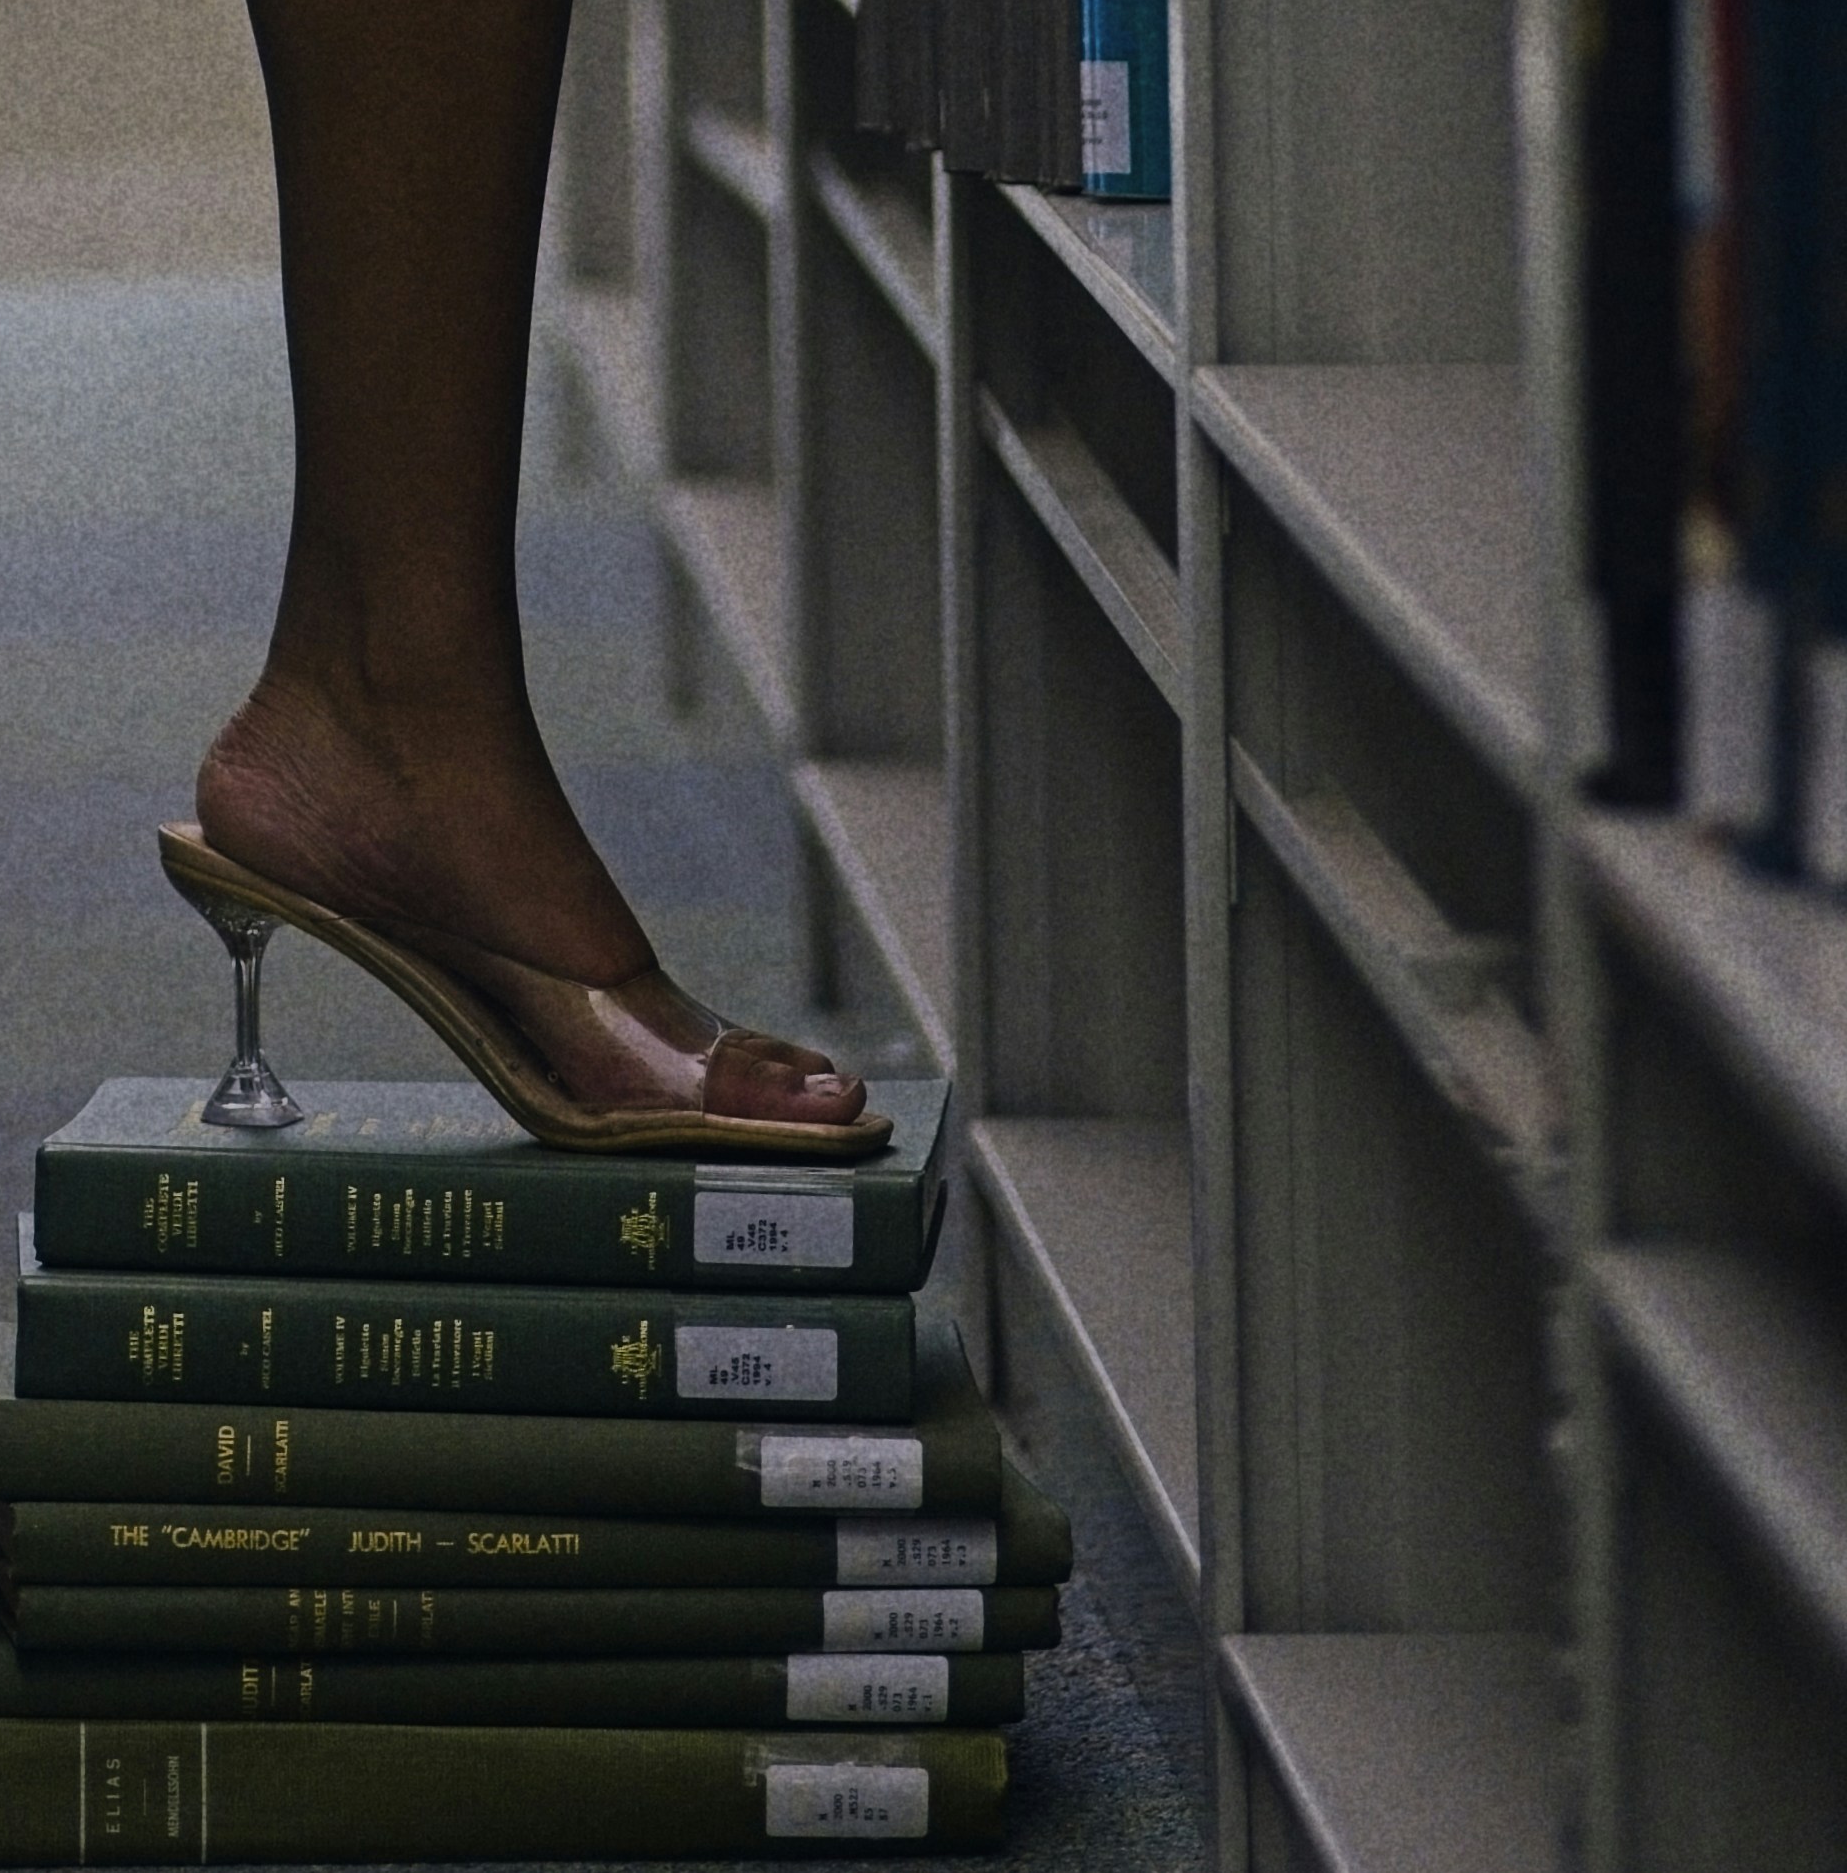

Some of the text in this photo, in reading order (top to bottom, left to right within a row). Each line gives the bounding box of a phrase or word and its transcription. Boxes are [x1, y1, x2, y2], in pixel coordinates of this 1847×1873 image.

[143, 1197, 155, 1230] THE
[157, 1173, 170, 1253] COMPLETE
[172, 1191, 184, 1237] VERDI
[186, 1180, 199, 1249] LIBRETTI
[275, 1176, 286, 1224] CASTEL
[347, 1185, 358, 1253] VOLUME IV
[726, 1230, 736, 1251] ML
[736, 1235, 746, 1252] 49
[758, 1219, 768, 1252] C372
[769, 1221, 778, 1252] 1994
[780, 1229, 790, 1253] v. 4
[129, 1330, 140, 1362] THE
[143, 1305, 156, 1386] COMPLETE
[158, 1323, 170, 1370] VERDI
[173, 1313, 185, 1382] LIBRETTI
[262, 1308, 273, 1357] CASTEL
[335, 1315, 346, 1385] VOLUME IV
[709, 1364, 719, 1386] ML
[720, 1369, 730, 1386] 49
[741, 1353, 751, 1386] C372
[753, 1355, 762, 1386] 1994
[764, 1362, 773, 1387] v. 4
[217, 1425, 236, 1485] DAVID
[274, 1420, 290, 1494] SCARLATTI
[872, 1461, 882, 1488] 1964
[110, 1524, 150, 1548] THE
[348, 1531, 422, 1553] JUDITH
[466, 1533, 580, 1556] SCARLATTI
[897, 1538, 907, 1567] 2000
[912, 1538, 922, 1566] .S29
[941, 1538, 952, 1566] 1964
[956, 1545, 967, 1567] v.3
[888, 1612, 899, 1639] 2000
[933, 1611, 944, 1638] 1964
[242, 1663, 259, 1715] JUDIT
[862, 1684, 873, 1711] 2000
[907, 1686, 917, 1712] 1964
[106, 1758, 121, 1834] ELIAS
[167, 1755, 180, 1838] MENDELSSOHN
[833, 1794, 844, 1820] 2000
